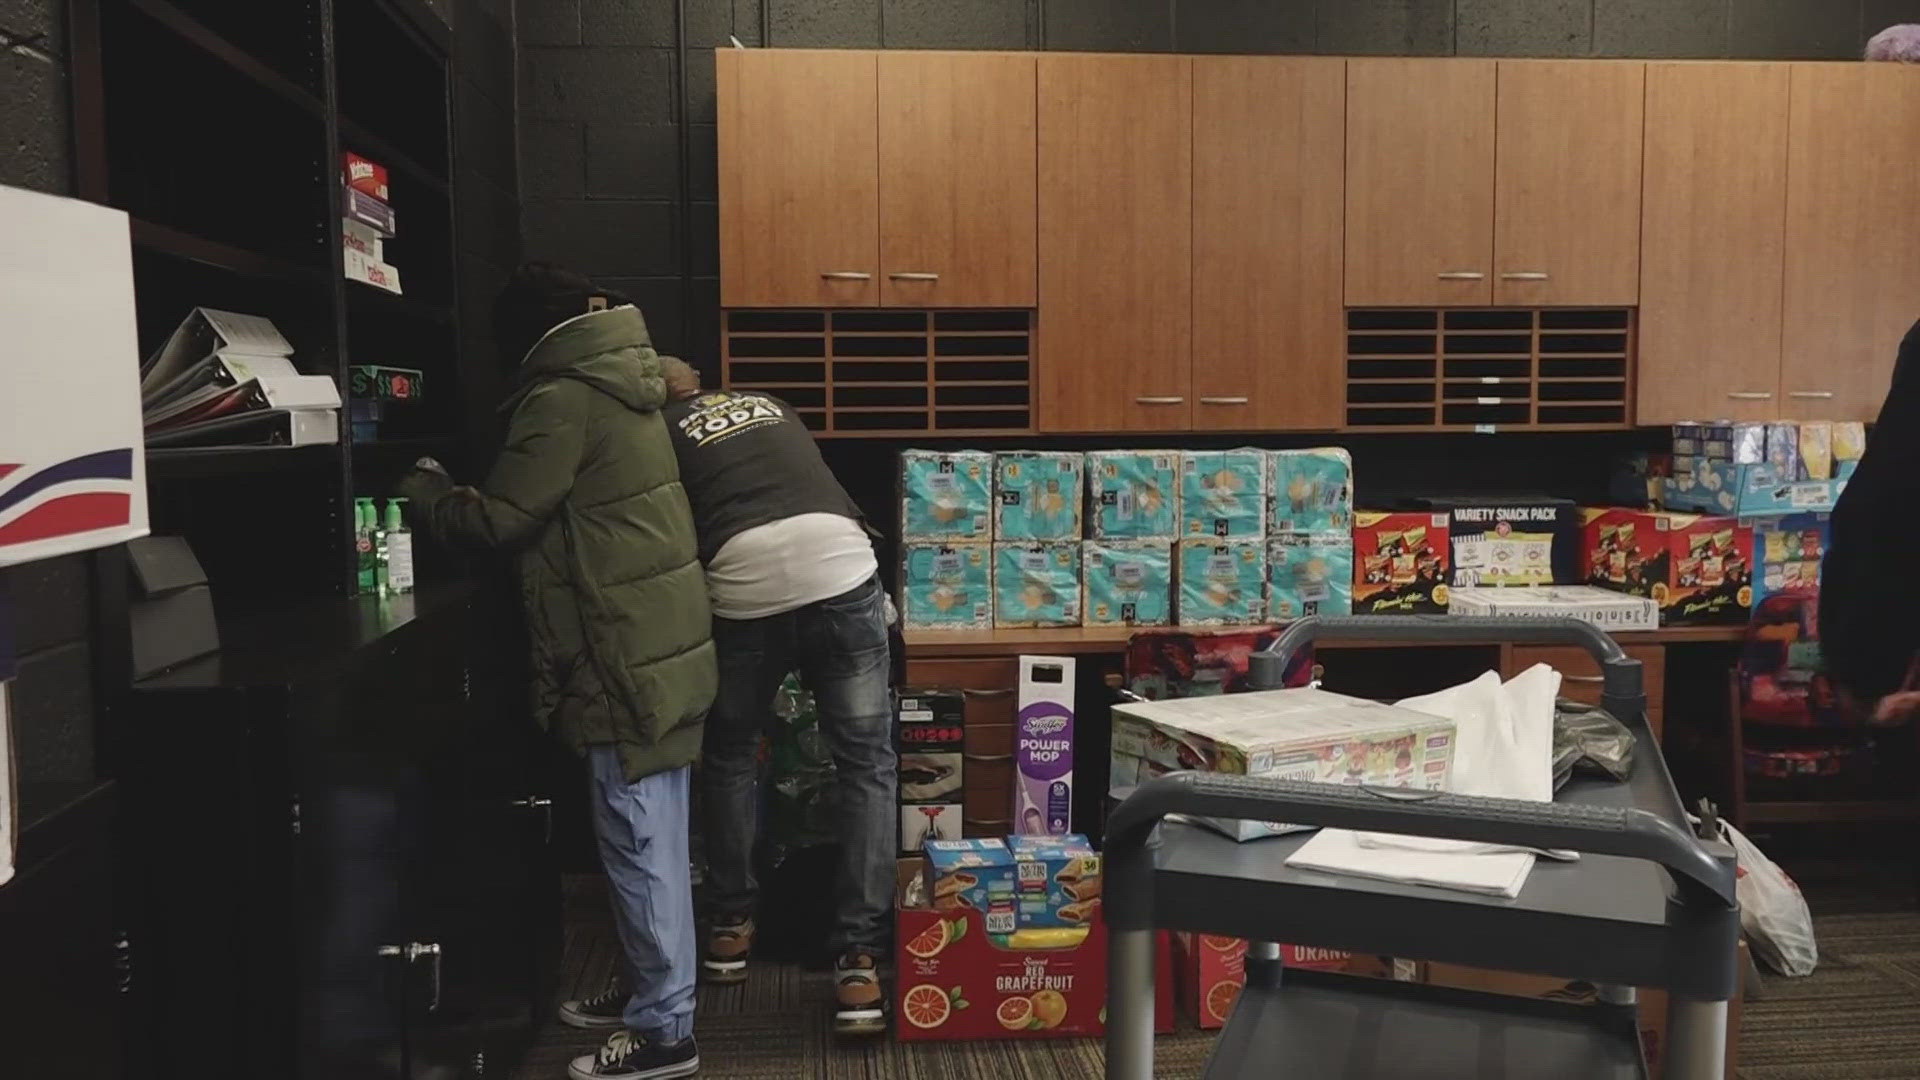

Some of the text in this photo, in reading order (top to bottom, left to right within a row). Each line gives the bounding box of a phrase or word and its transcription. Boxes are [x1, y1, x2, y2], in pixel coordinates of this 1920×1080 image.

[685, 397, 784, 442] TODAY
[1454, 508, 1557, 521] VARIETY SNACK PACK
[1020, 739, 1070, 752] POWER
[1030, 751, 1060, 762] MOP
[1025, 966, 1045, 977] RED
[996, 975, 1074, 990] GRAPEFRUIT
